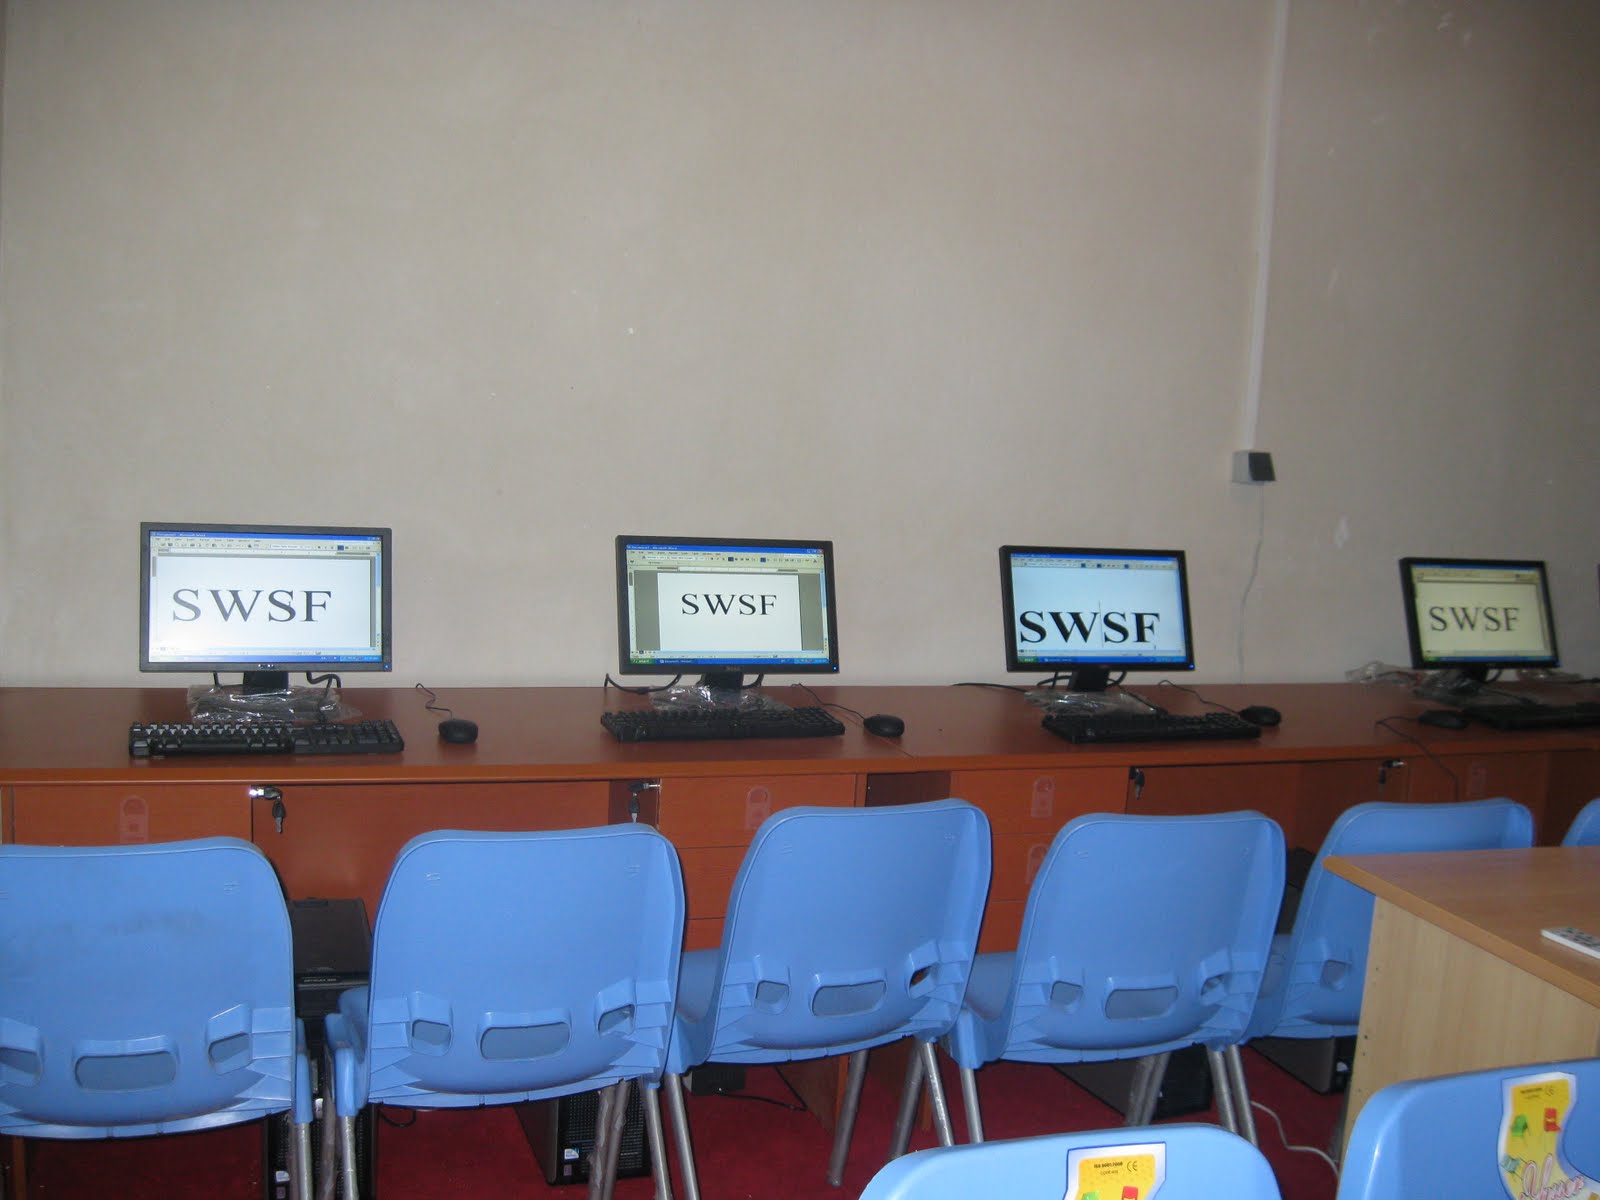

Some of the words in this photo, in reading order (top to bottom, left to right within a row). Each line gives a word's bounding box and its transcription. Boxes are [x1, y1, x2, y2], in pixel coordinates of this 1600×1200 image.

[173, 588, 332, 623] SWSF
[681, 593, 777, 616] SWSF
[1428, 606, 1520, 632] SWSF
[1019, 610, 1161, 643] SWSF
